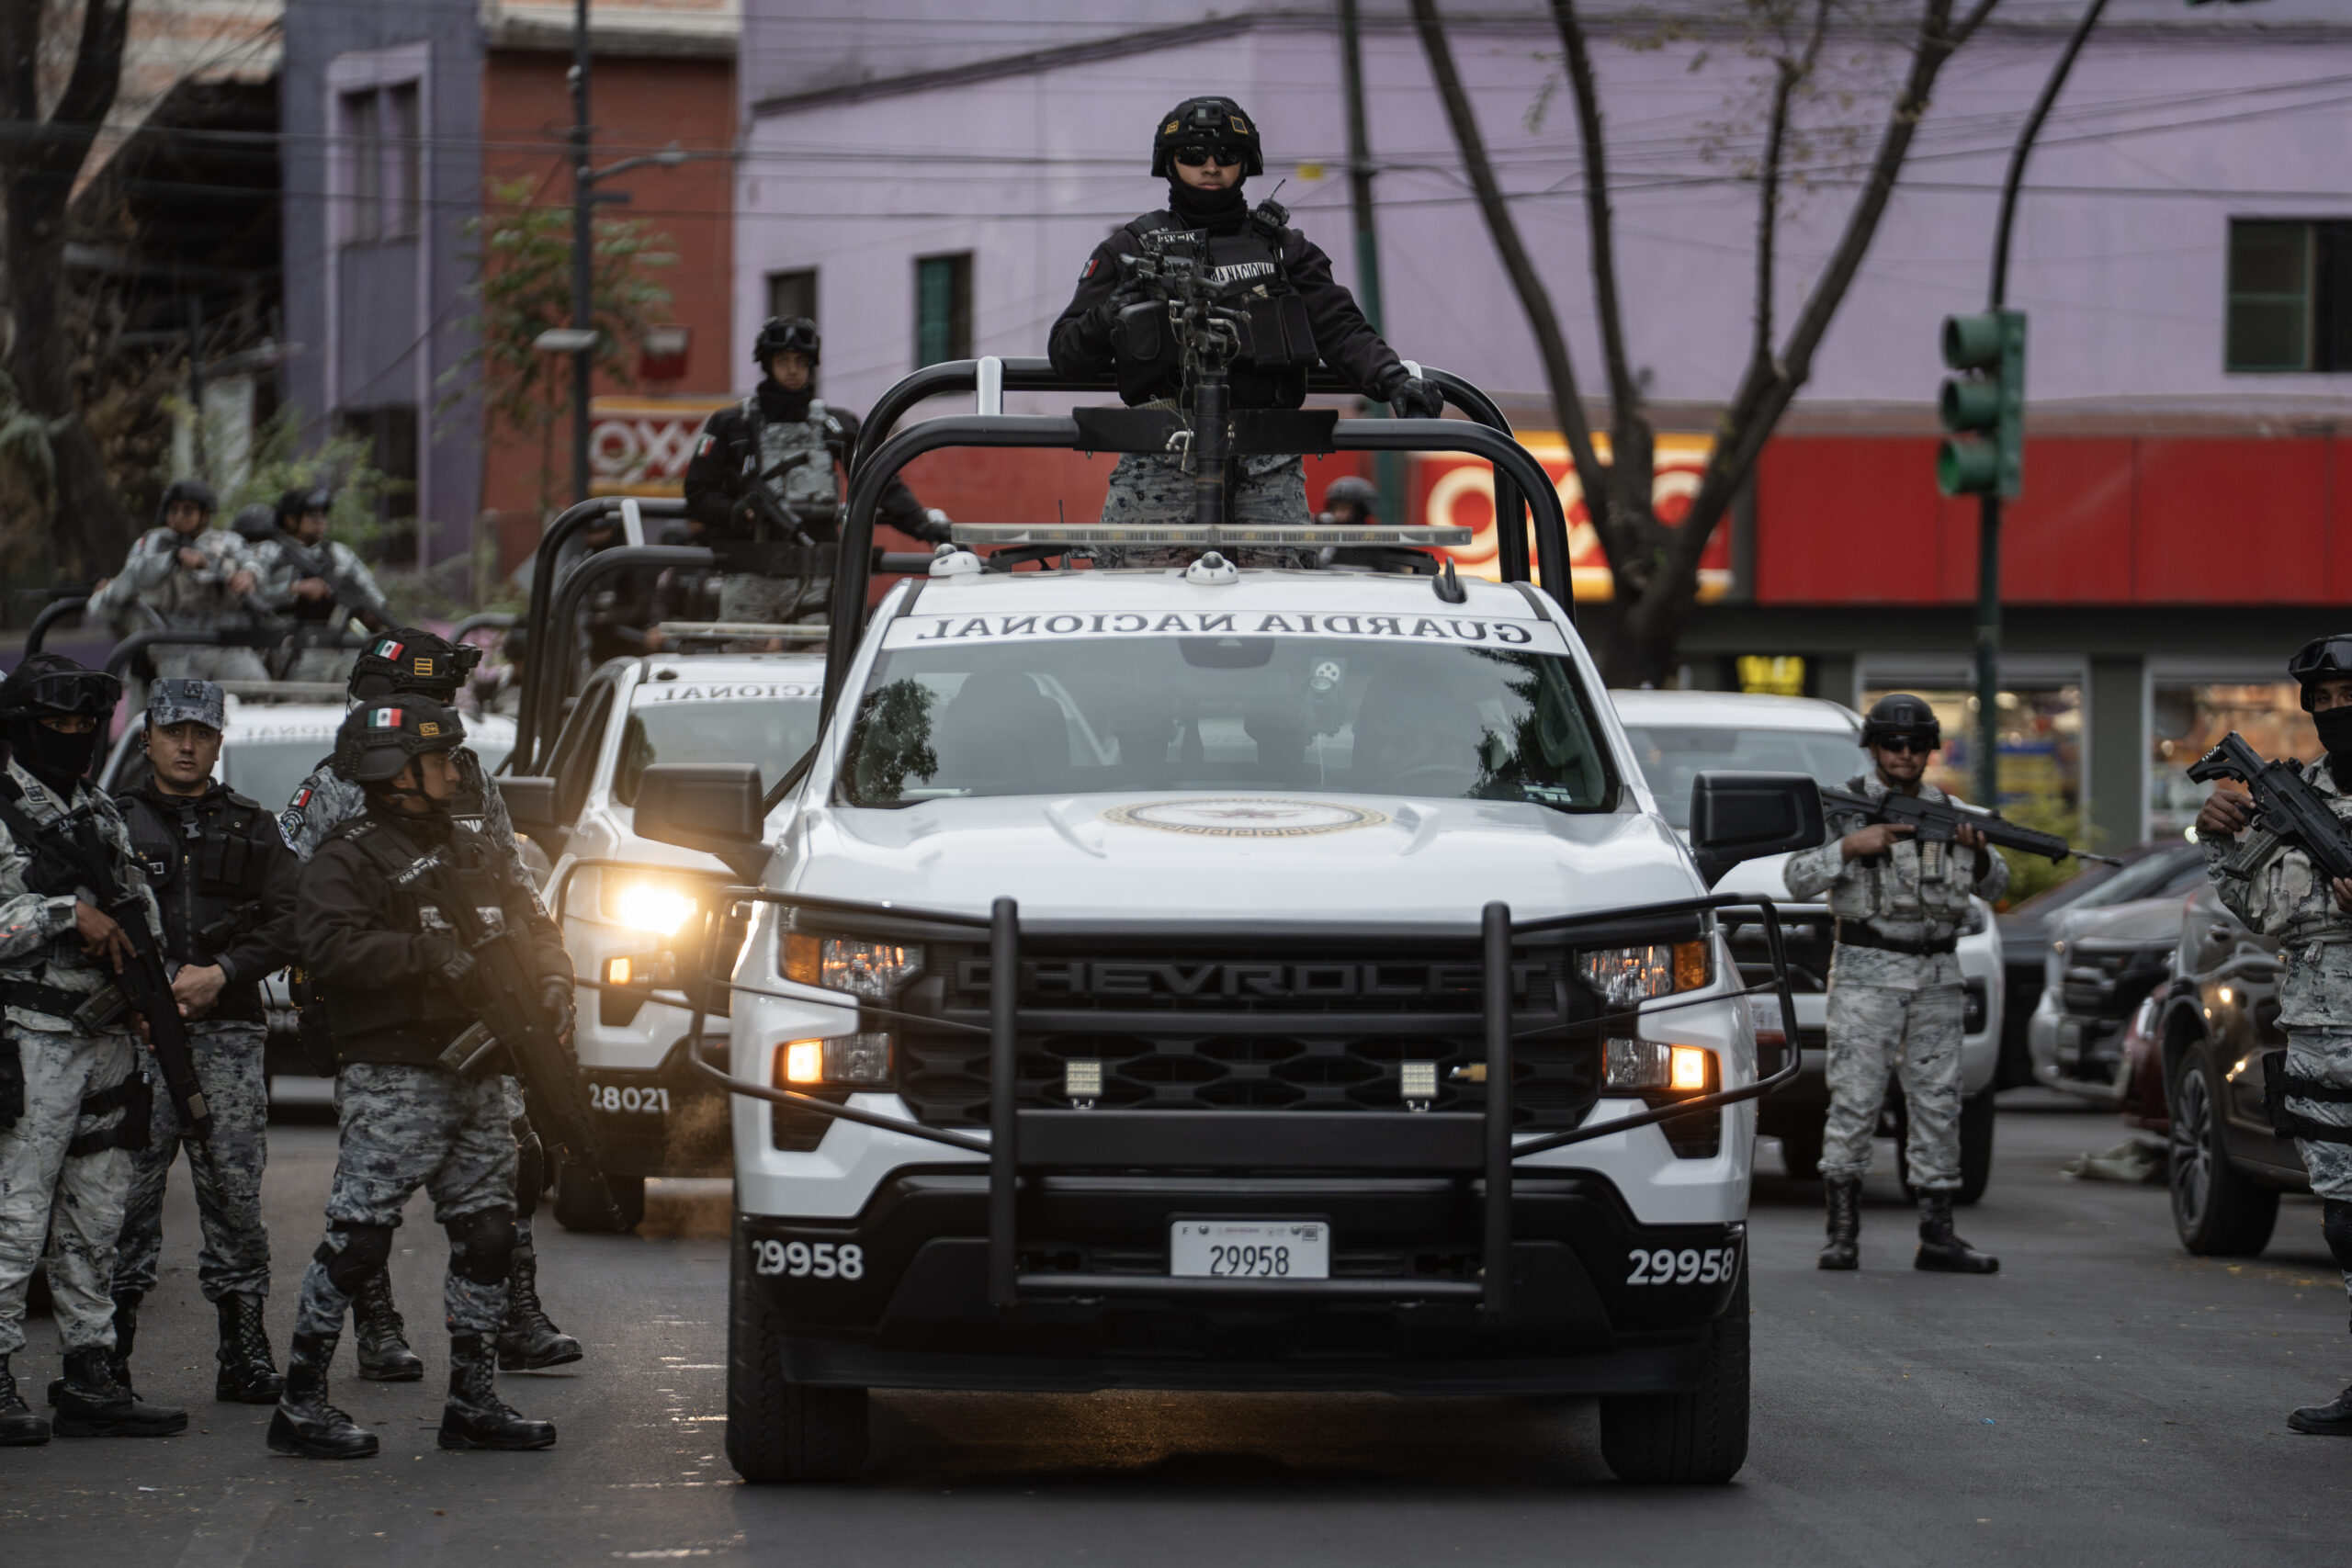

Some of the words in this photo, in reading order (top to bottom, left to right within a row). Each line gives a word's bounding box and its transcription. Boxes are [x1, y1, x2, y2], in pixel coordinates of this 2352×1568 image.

[588, 419, 708, 483] OXX
[957, 960, 1548, 994] CHEVROLET
[588, 1083, 670, 1113] 28021
[752, 1239, 865, 1280] 29958
[1210, 1245, 1289, 1276] 29958
[1626, 1247, 1735, 1285] 29958
